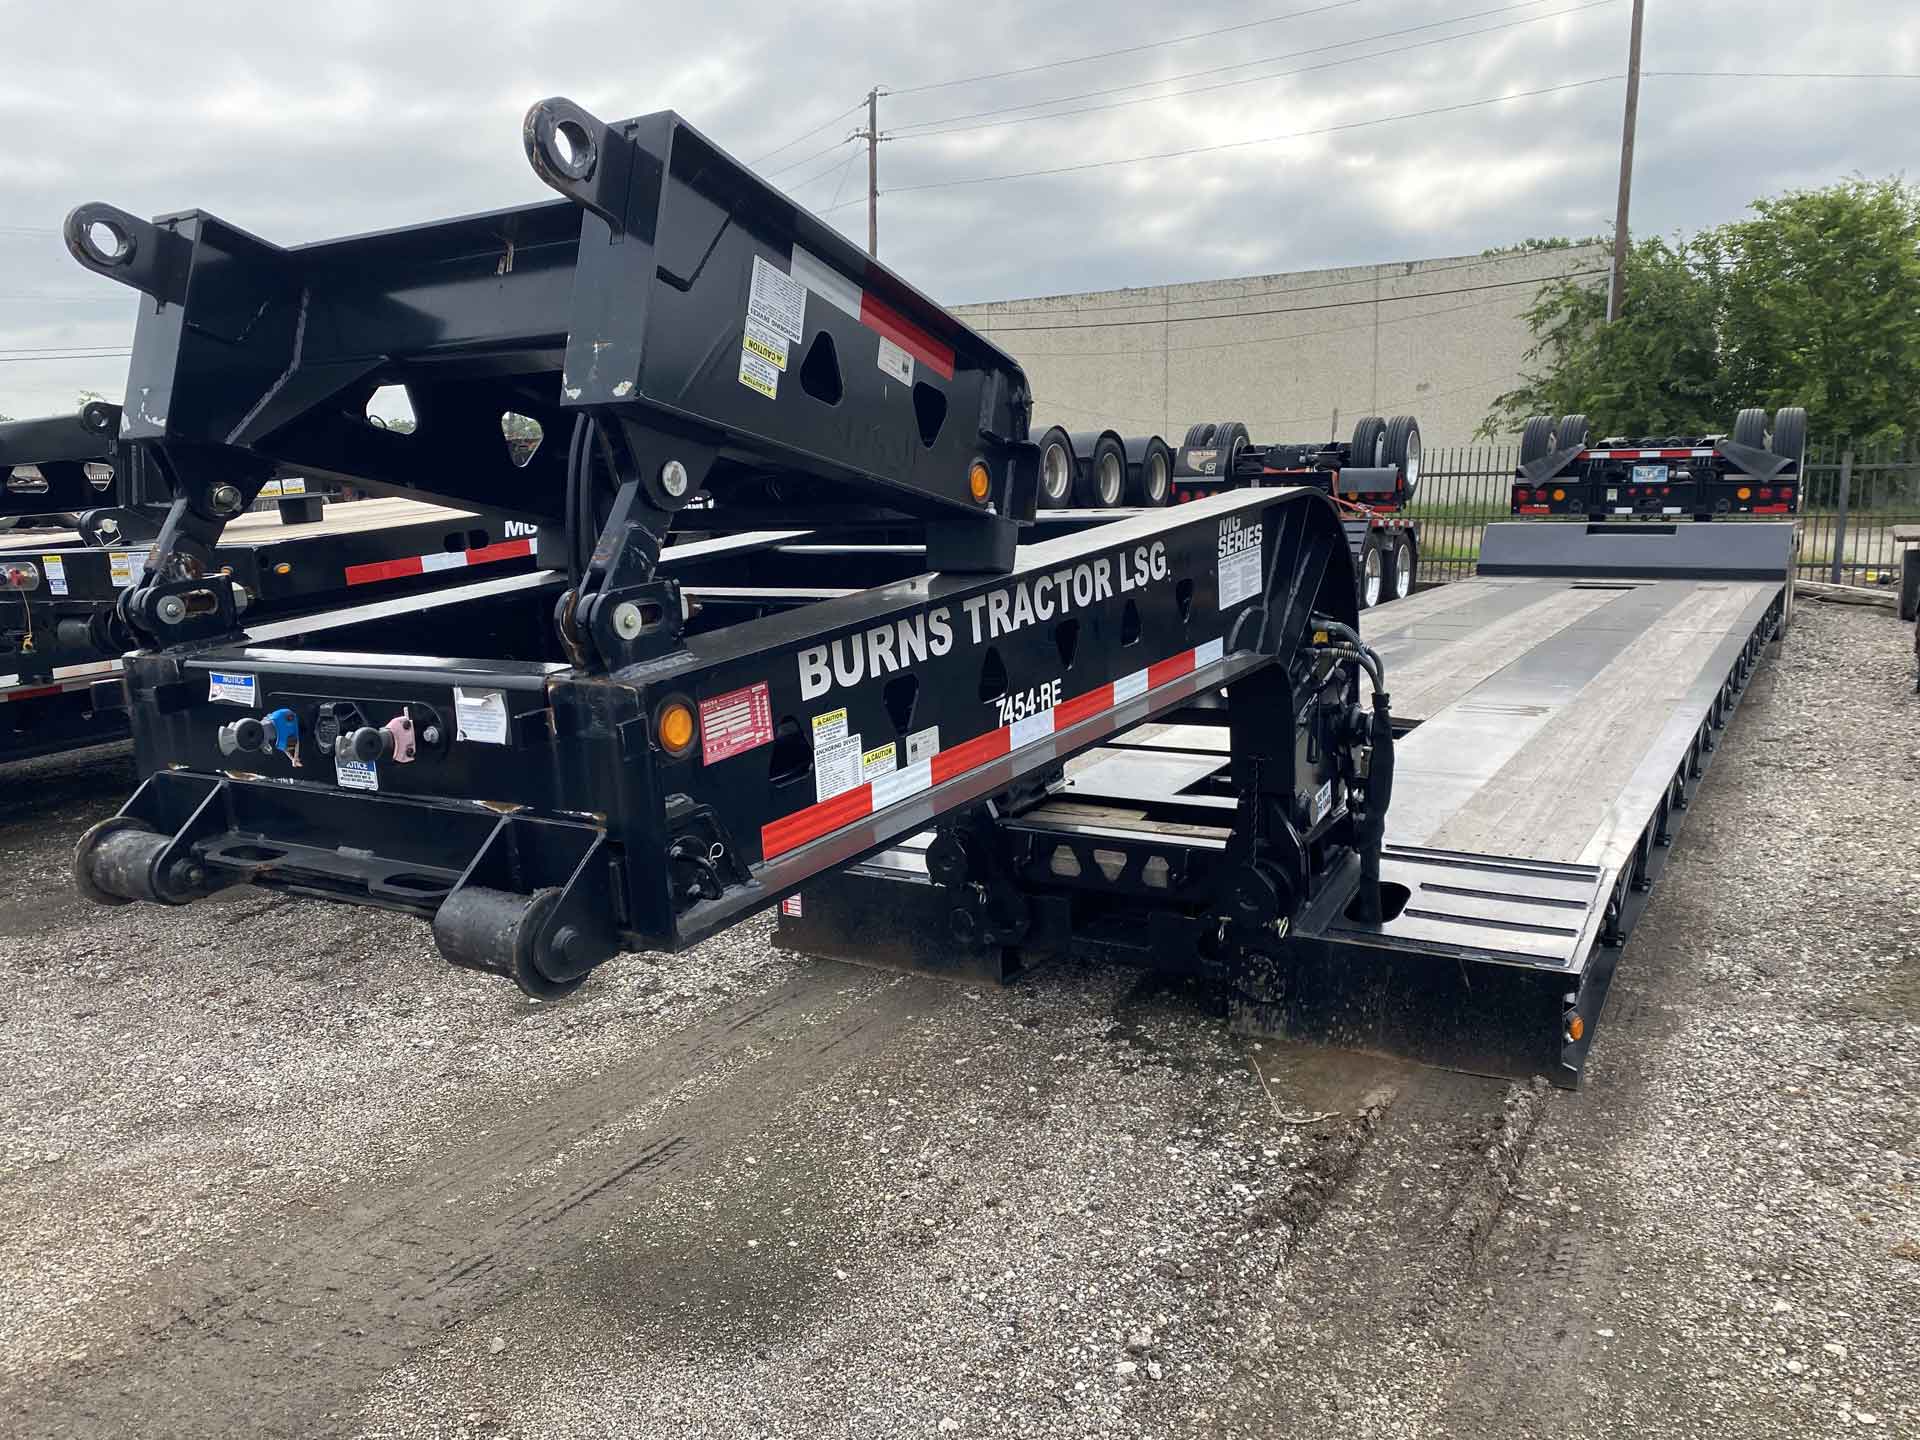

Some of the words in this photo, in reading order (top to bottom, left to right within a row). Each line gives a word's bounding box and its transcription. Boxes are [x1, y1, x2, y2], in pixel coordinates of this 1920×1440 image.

[748, 339, 776, 361] CAUTION
[743, 375, 766, 391] CAUTION
[1218, 524, 1263, 558] SERIES
[798, 606, 953, 702] BURNS
[962, 558, 1113, 645] TRACTOR
[822, 711, 844, 724] CAUTION
[815, 743, 842, 756] ANCHORING
[843, 736, 860, 747] DEVICES
[871, 747, 893, 760] CAUTION
